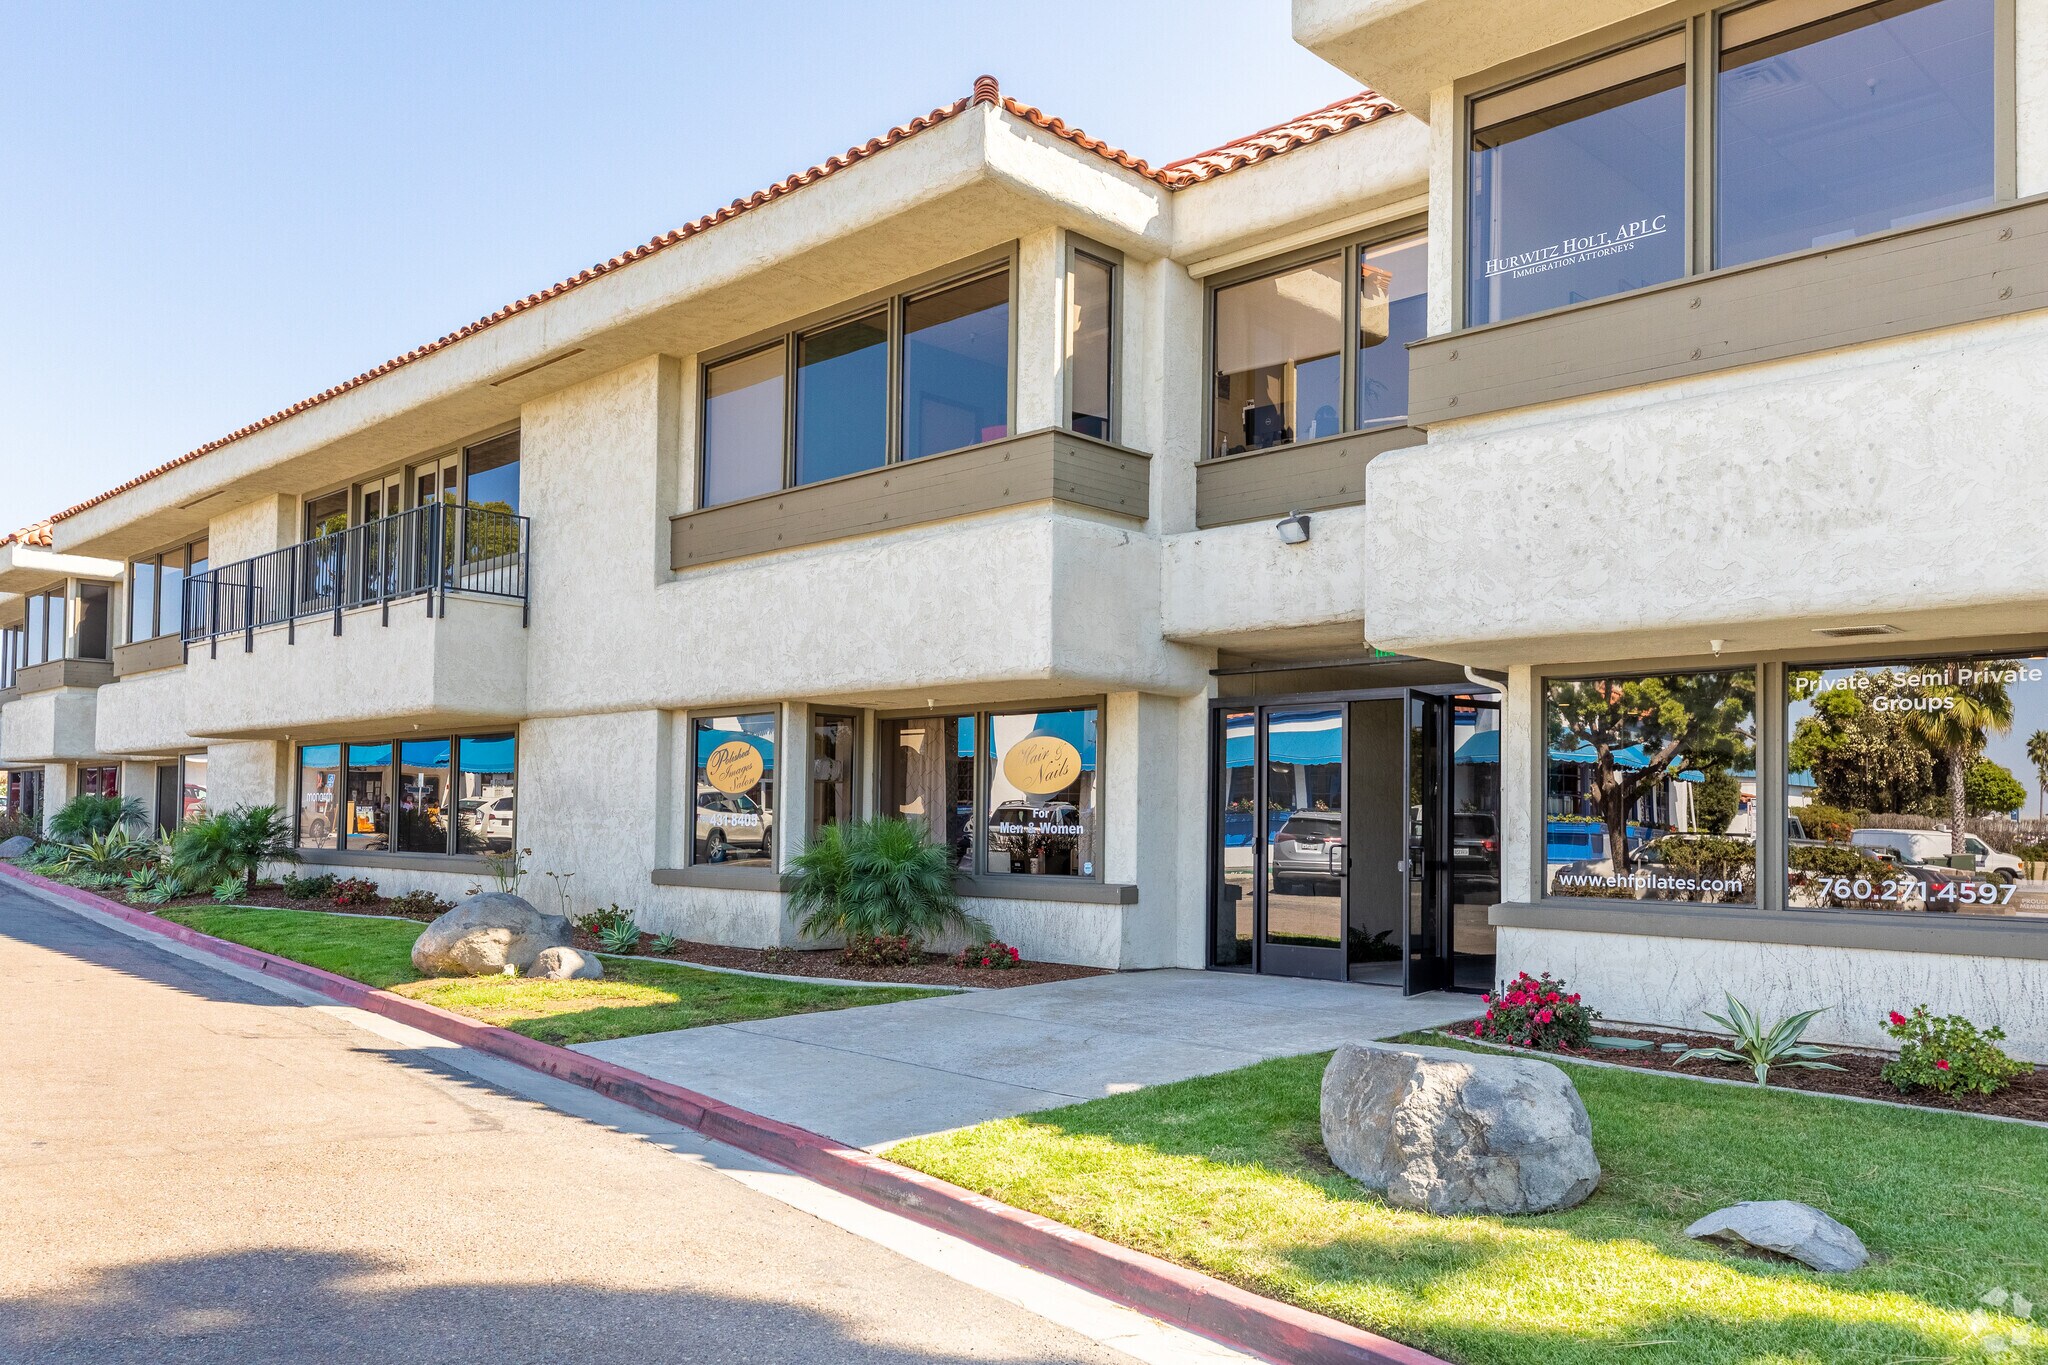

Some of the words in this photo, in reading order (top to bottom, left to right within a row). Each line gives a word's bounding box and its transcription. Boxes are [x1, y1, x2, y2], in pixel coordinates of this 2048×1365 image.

[1485, 245, 1559, 275] HURWITZ
[1563, 232, 1612, 254] HOLT,
[1615, 214, 1666, 241] APLC
[1512, 257, 1576, 279] IMMIGRATION
[1578, 242, 1634, 263] ATTORNEYS
[1795, 676, 1870, 692] Private
[1893, 671, 1949, 687] Semi
[1958, 666, 2043, 685] Private
[1872, 696, 1955, 712] Groups
[710, 744, 752, 775] Polished
[1019, 743, 1049, 766] Hair
[719, 763, 753, 781] Images
[730, 775, 755, 791] Salon
[1023, 757, 1069, 787] Nails
[1032, 808, 1049, 818] For
[1000, 822, 1024, 834] Men
[1027, 822, 1037, 834] &
[1040, 822, 1084, 834] Women
[1559, 873, 1743, 892] www.ehfpilates.com
[1818, 878, 2017, 905] 760.271.4597
